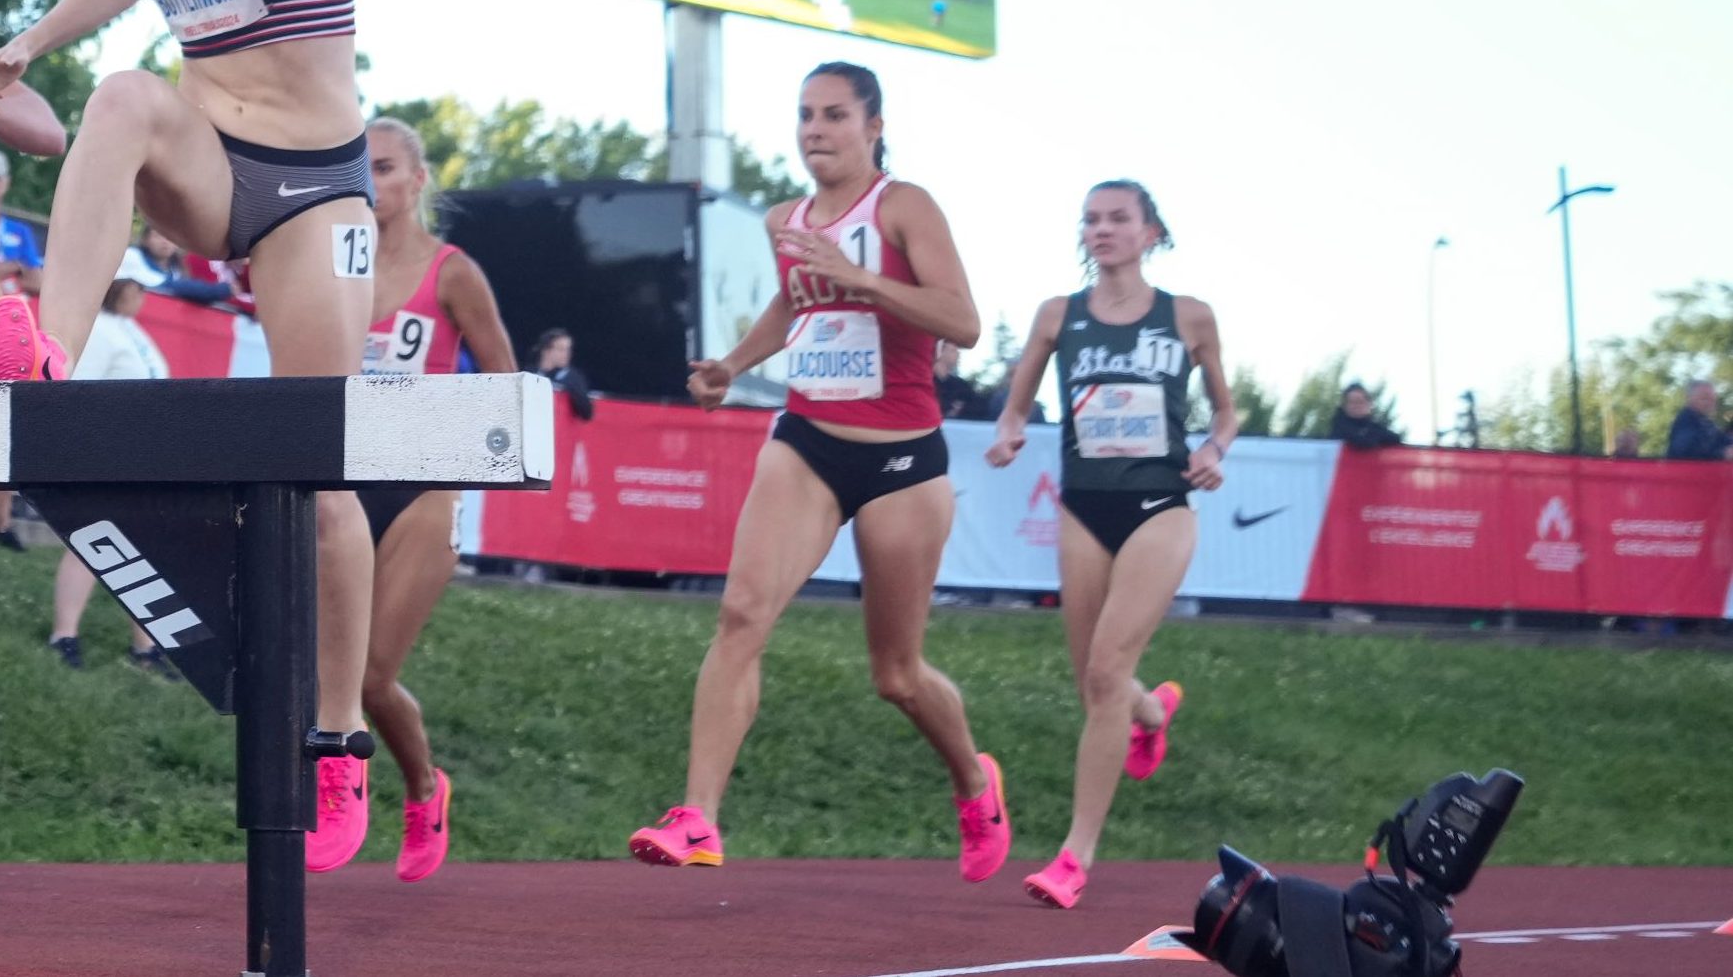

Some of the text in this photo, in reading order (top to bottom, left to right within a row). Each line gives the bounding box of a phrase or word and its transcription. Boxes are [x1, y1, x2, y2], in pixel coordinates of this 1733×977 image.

[342, 228, 370, 275] 13
[850, 226, 866, 267] 1
[396, 318, 423, 360] 9
[1149, 340, 1173, 370] 11
[787, 349, 877, 379] LACOURSE
[68, 520, 202, 649] GILL
